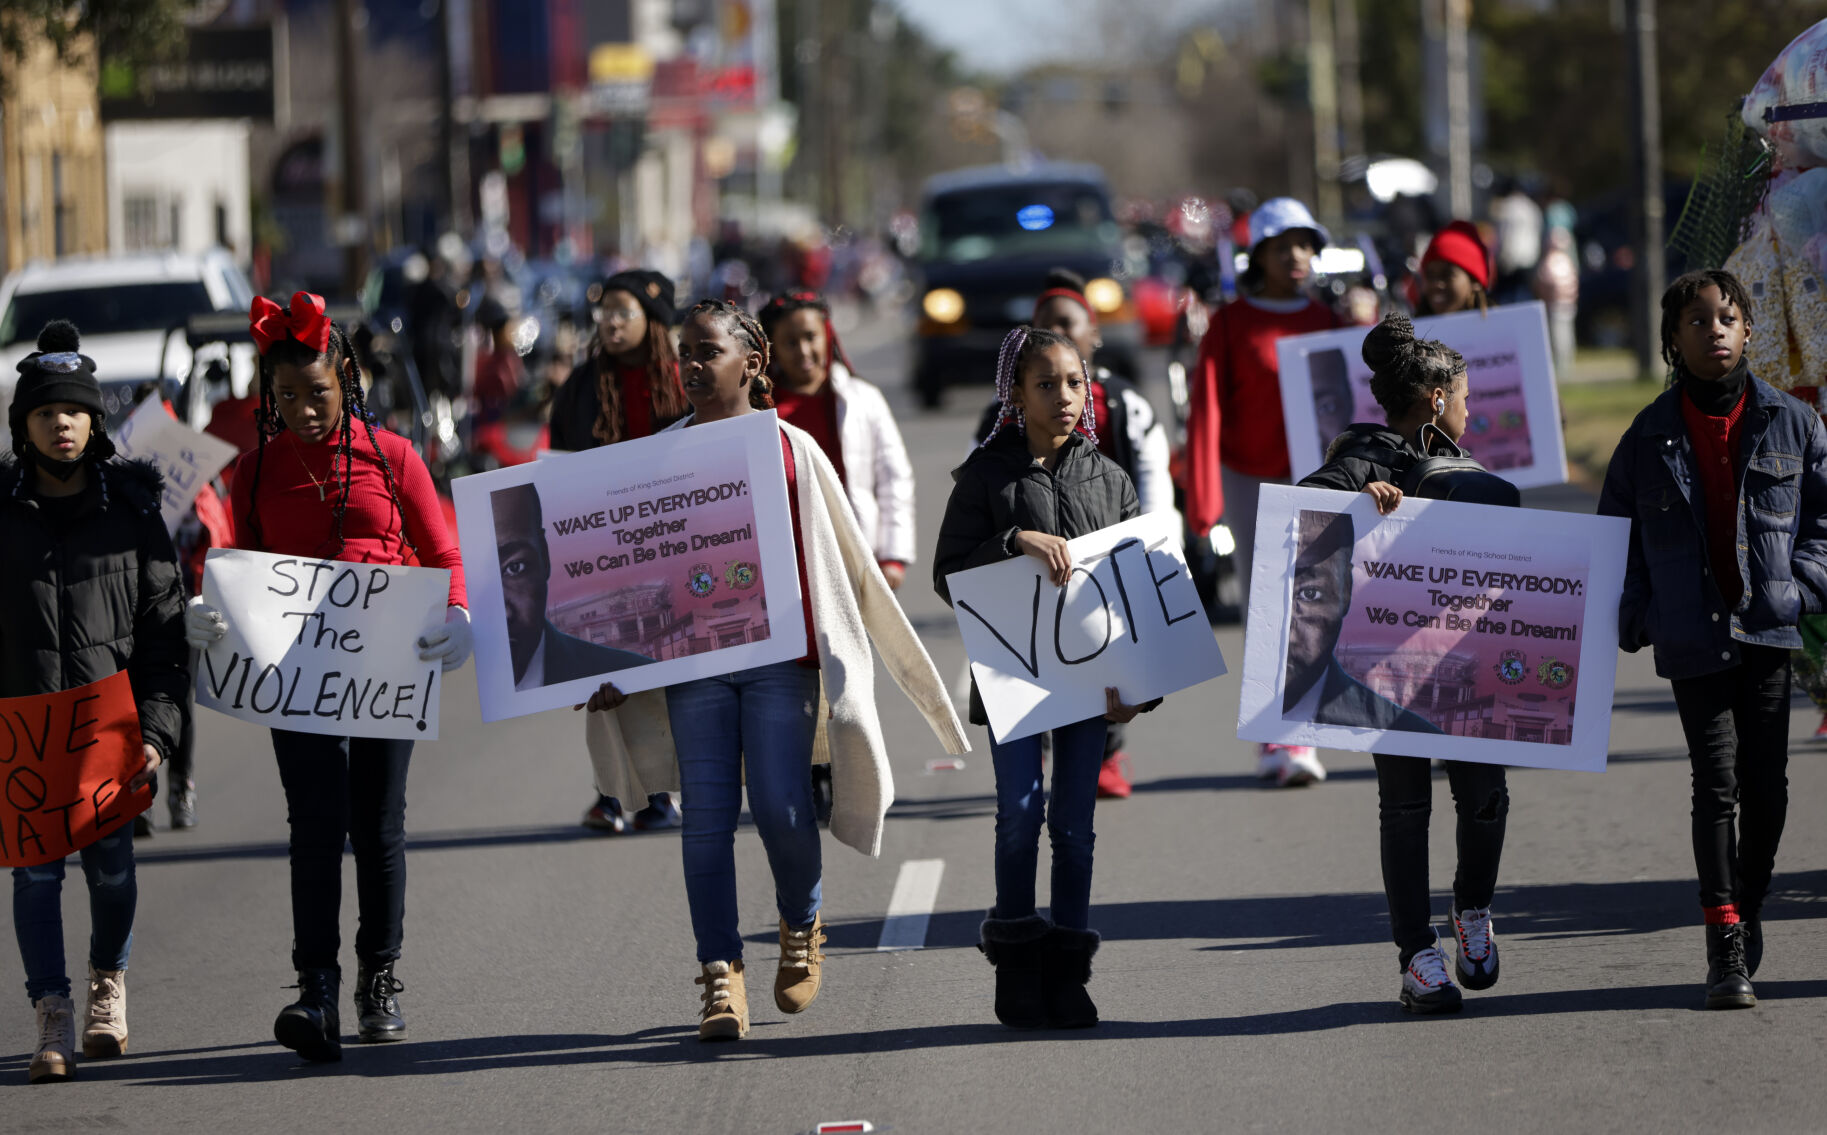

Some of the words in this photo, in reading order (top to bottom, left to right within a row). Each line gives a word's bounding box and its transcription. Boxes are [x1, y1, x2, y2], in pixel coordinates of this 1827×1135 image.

[606, 486, 629, 497] Friends
[637, 481, 652, 490] King
[652, 477, 672, 487] School
[673, 472, 695, 482] District
[552, 511, 607, 537] WAKE
[609, 505, 635, 524] UP
[638, 480, 748, 519] EVERYBODY:
[564, 560, 594, 578] We
[597, 553, 630, 571] Can
[633, 547, 657, 564] Be
[659, 541, 688, 558] the
[691, 523, 752, 552] Dream!
[612, 518, 688, 546] Together
[1431, 547, 1457, 556] Friends
[1466, 550, 1482, 558] King
[1483, 551, 1507, 560] School
[1508, 553, 1532, 562] District
[267, 559, 389, 610] STOP
[1363, 560, 1425, 582] WAKE
[1428, 566, 1458, 584] UP
[1461, 569, 1583, 597] EVERYBODY:
[956, 536, 1197, 679] VOTE
[1427, 589, 1513, 613] Together
[282, 611, 364, 653] The
[1365, 606, 1399, 626] We
[1403, 610, 1441, 629] Can
[1446, 613, 1472, 632] Be
[1476, 616, 1507, 635] the
[1510, 619, 1577, 641] Dream!
[204, 649, 435, 732] VIOLENCE!
